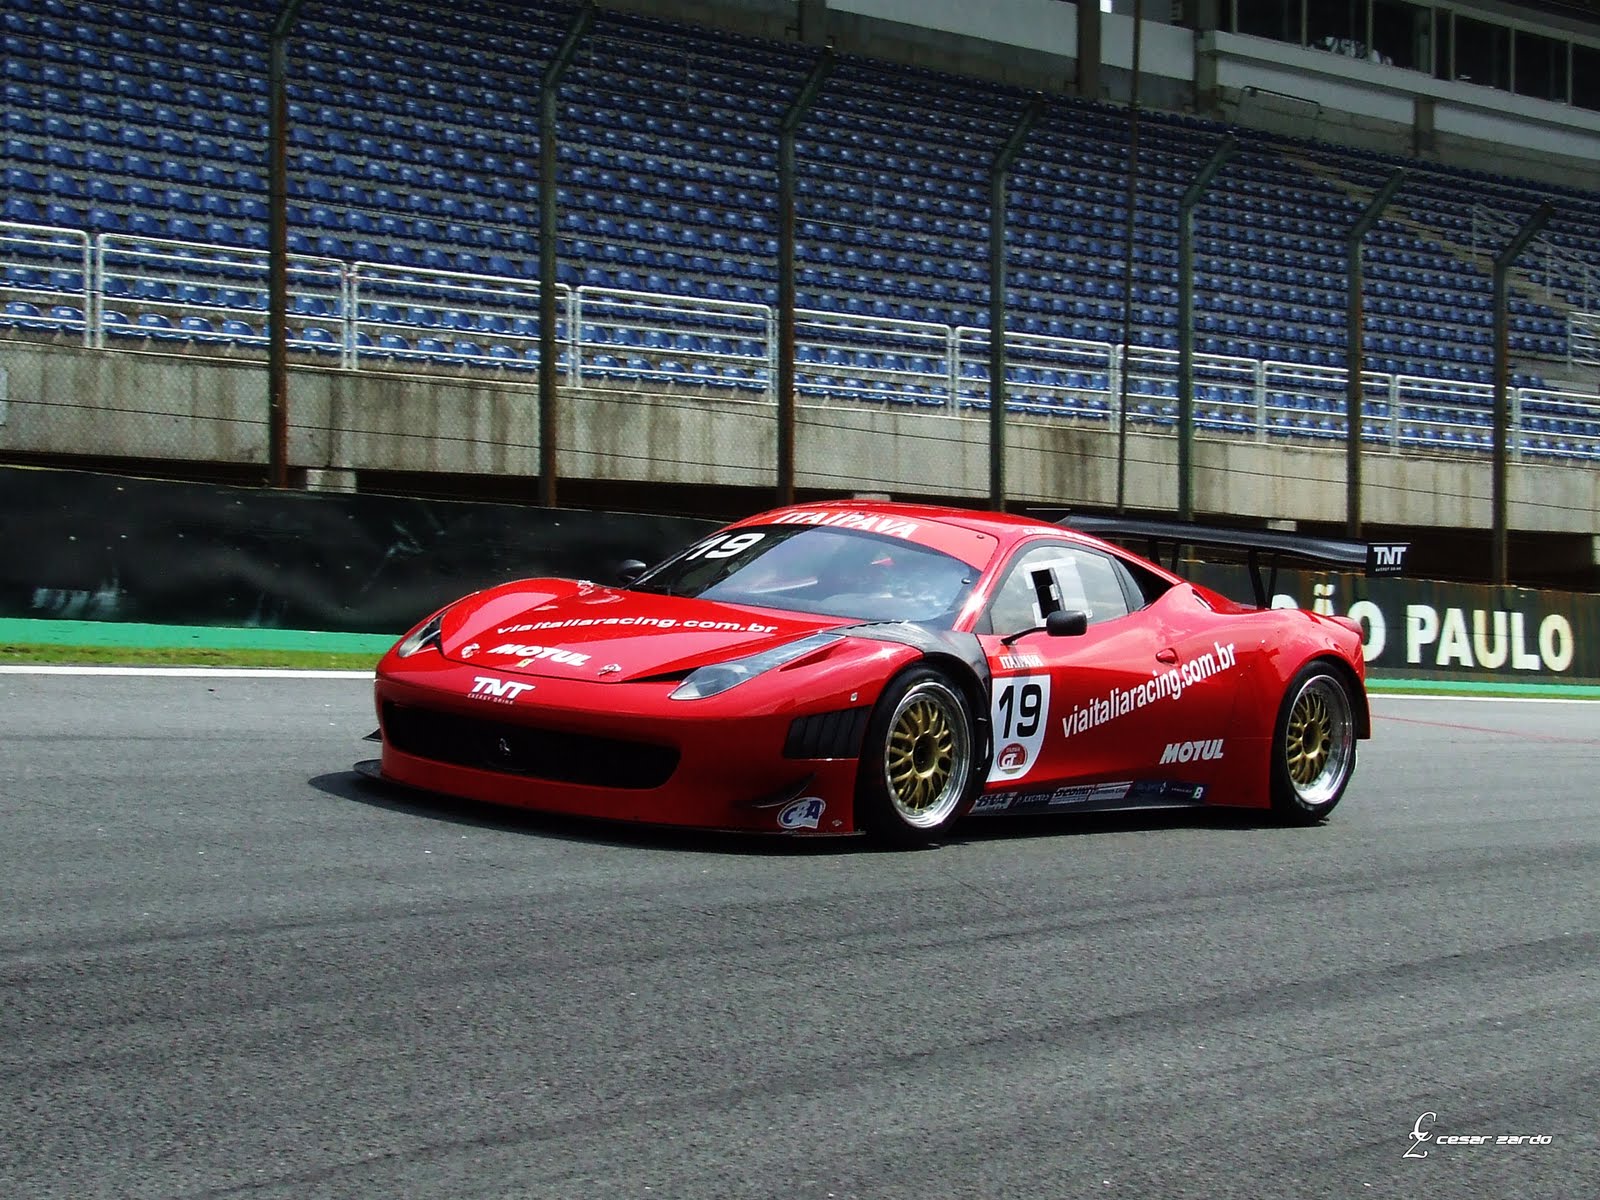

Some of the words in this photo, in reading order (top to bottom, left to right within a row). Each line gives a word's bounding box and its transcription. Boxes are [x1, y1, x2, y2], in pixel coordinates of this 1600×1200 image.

[771, 511, 919, 539] ITAIPAVA
[685, 532, 766, 561] 19
[1373, 546, 1407, 565] TNT
[497, 616, 779, 635] viaitaliaracing.com.br
[1406, 604, 1575, 672] PAULO
[487, 643, 592, 667] MOTUL
[471, 676, 536, 700] TNT
[1062, 641, 1237, 739] viaitaliaracing.com.br
[998, 683, 1042, 739] 19
[1159, 739, 1224, 765] MOTUL
